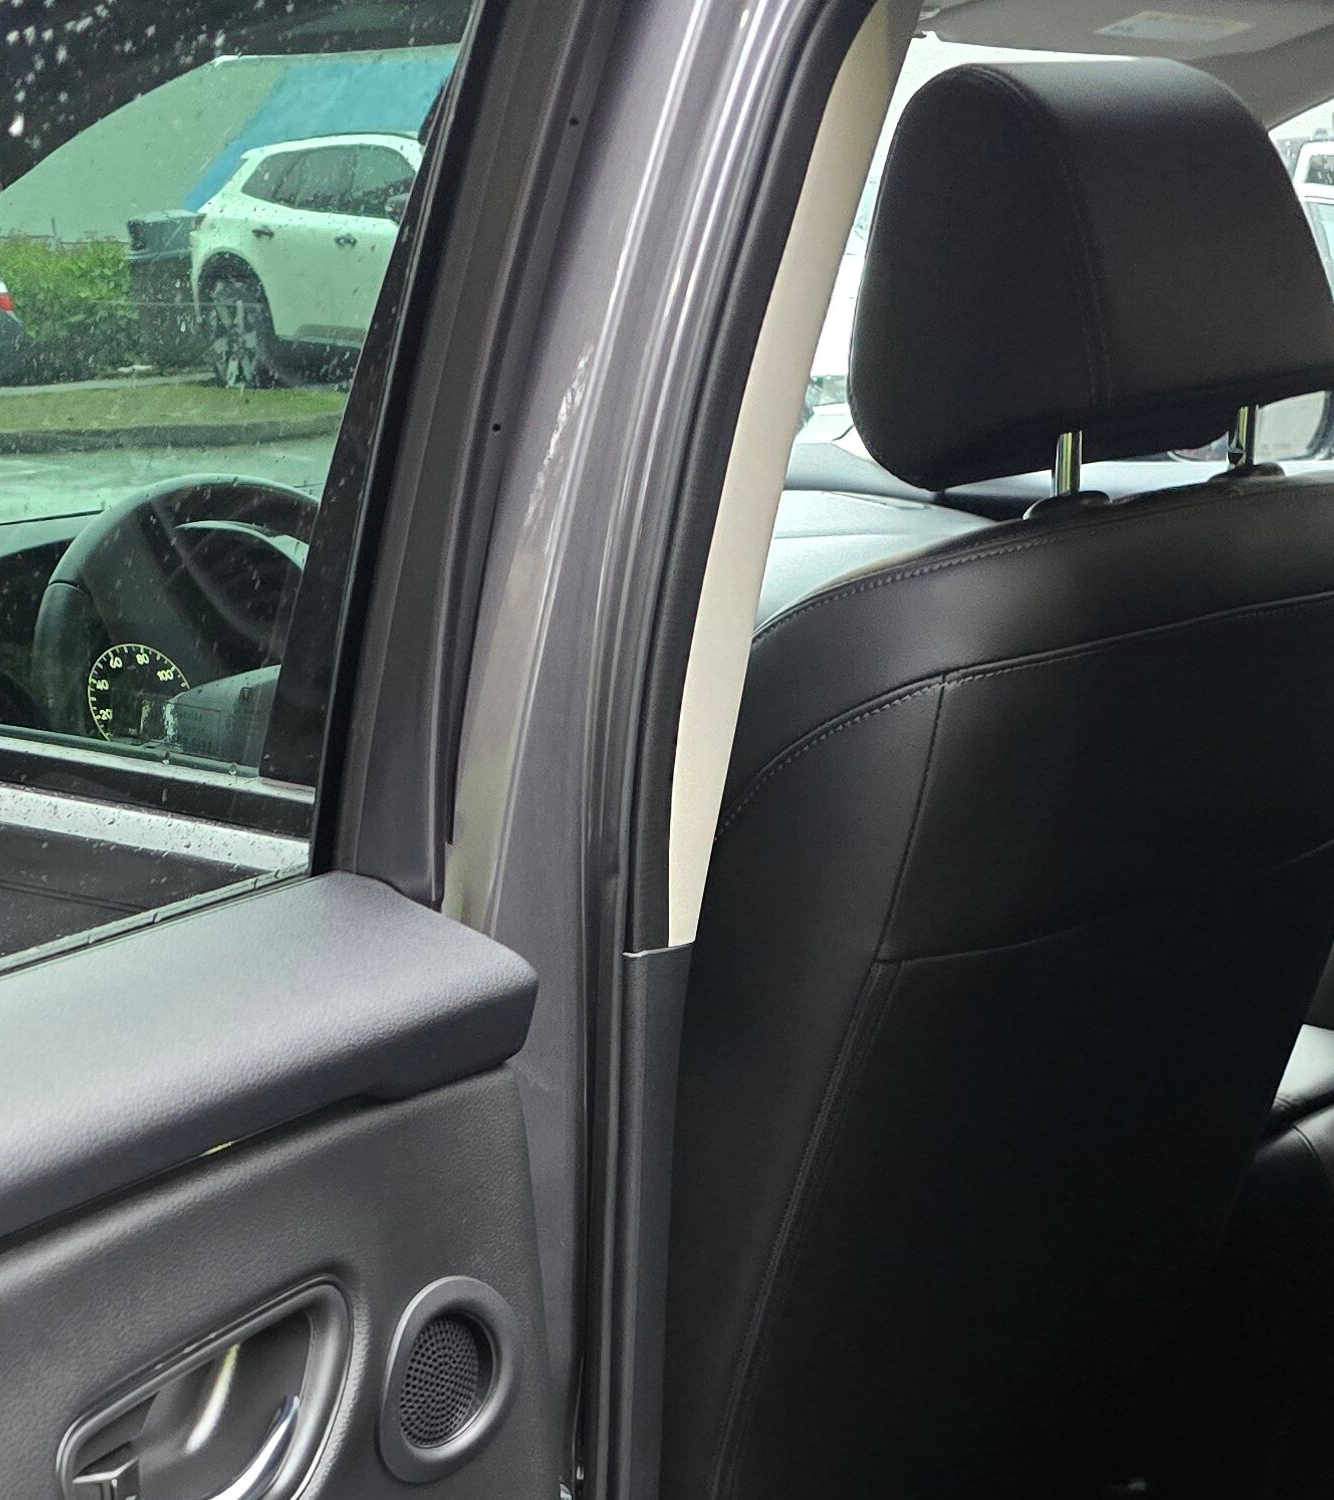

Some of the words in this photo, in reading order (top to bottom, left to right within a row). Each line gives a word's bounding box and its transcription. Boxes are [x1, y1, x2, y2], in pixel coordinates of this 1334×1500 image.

[109, 657, 123, 669] 60
[136, 653, 150, 665] 80
[156, 669, 174, 681] 100
[96, 679, 110, 691] 40
[99, 708, 113, 721] 20
